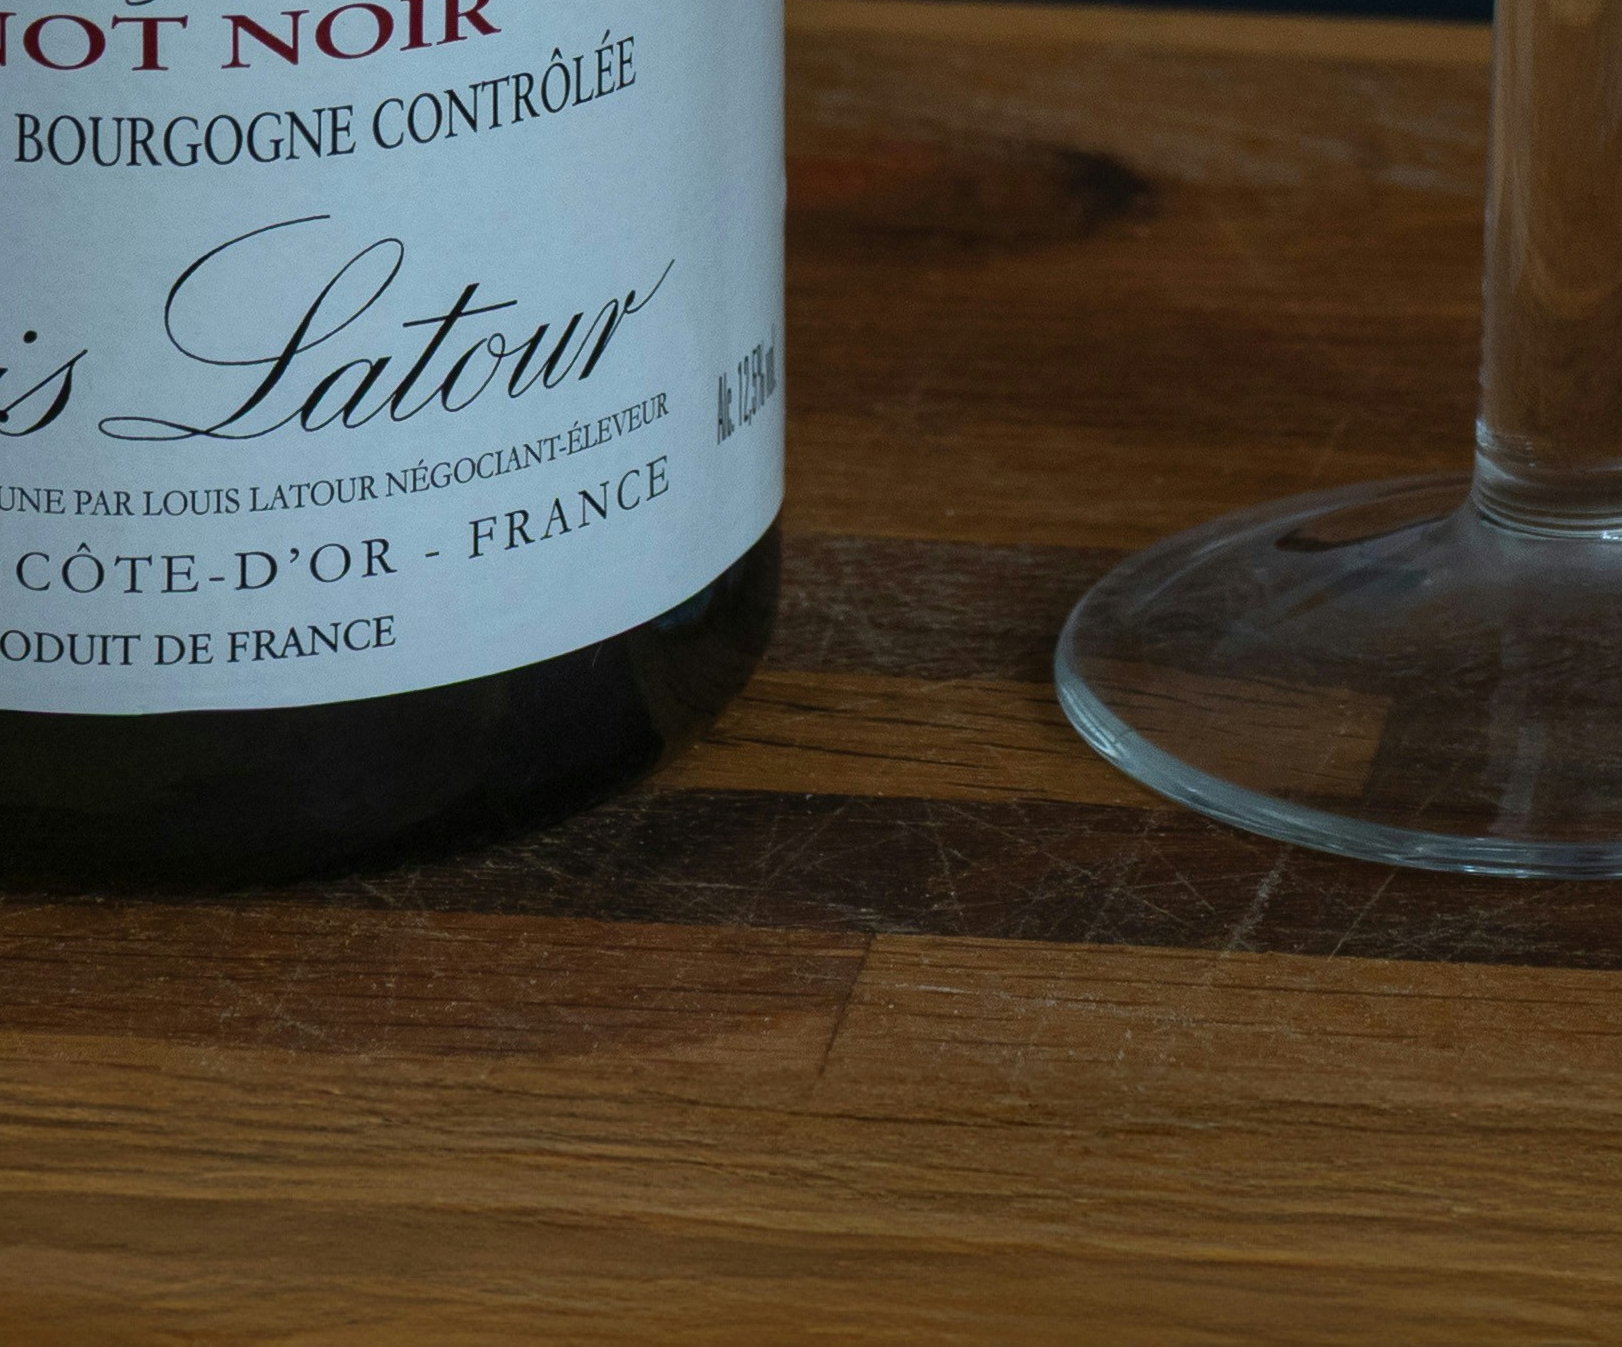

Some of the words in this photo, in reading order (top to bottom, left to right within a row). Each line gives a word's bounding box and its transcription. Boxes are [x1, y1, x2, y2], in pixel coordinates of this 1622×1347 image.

[14, 104, 357, 168] BOURGOGNE
[372, 28, 637, 150] CONTRÔLÉE
[97, 214, 675, 442] Latour
[73, 489, 135, 517] PAR
[142, 487, 241, 517] LOUIS
[249, 475, 379, 513] LATOUR
[385, 392, 669, 498] NÉGOCIANT-ÉLEVEUR
[467, 455, 671, 560] FRANCE
[154, 633, 214, 666] DE
[226, 614, 397, 664] FRANCE
